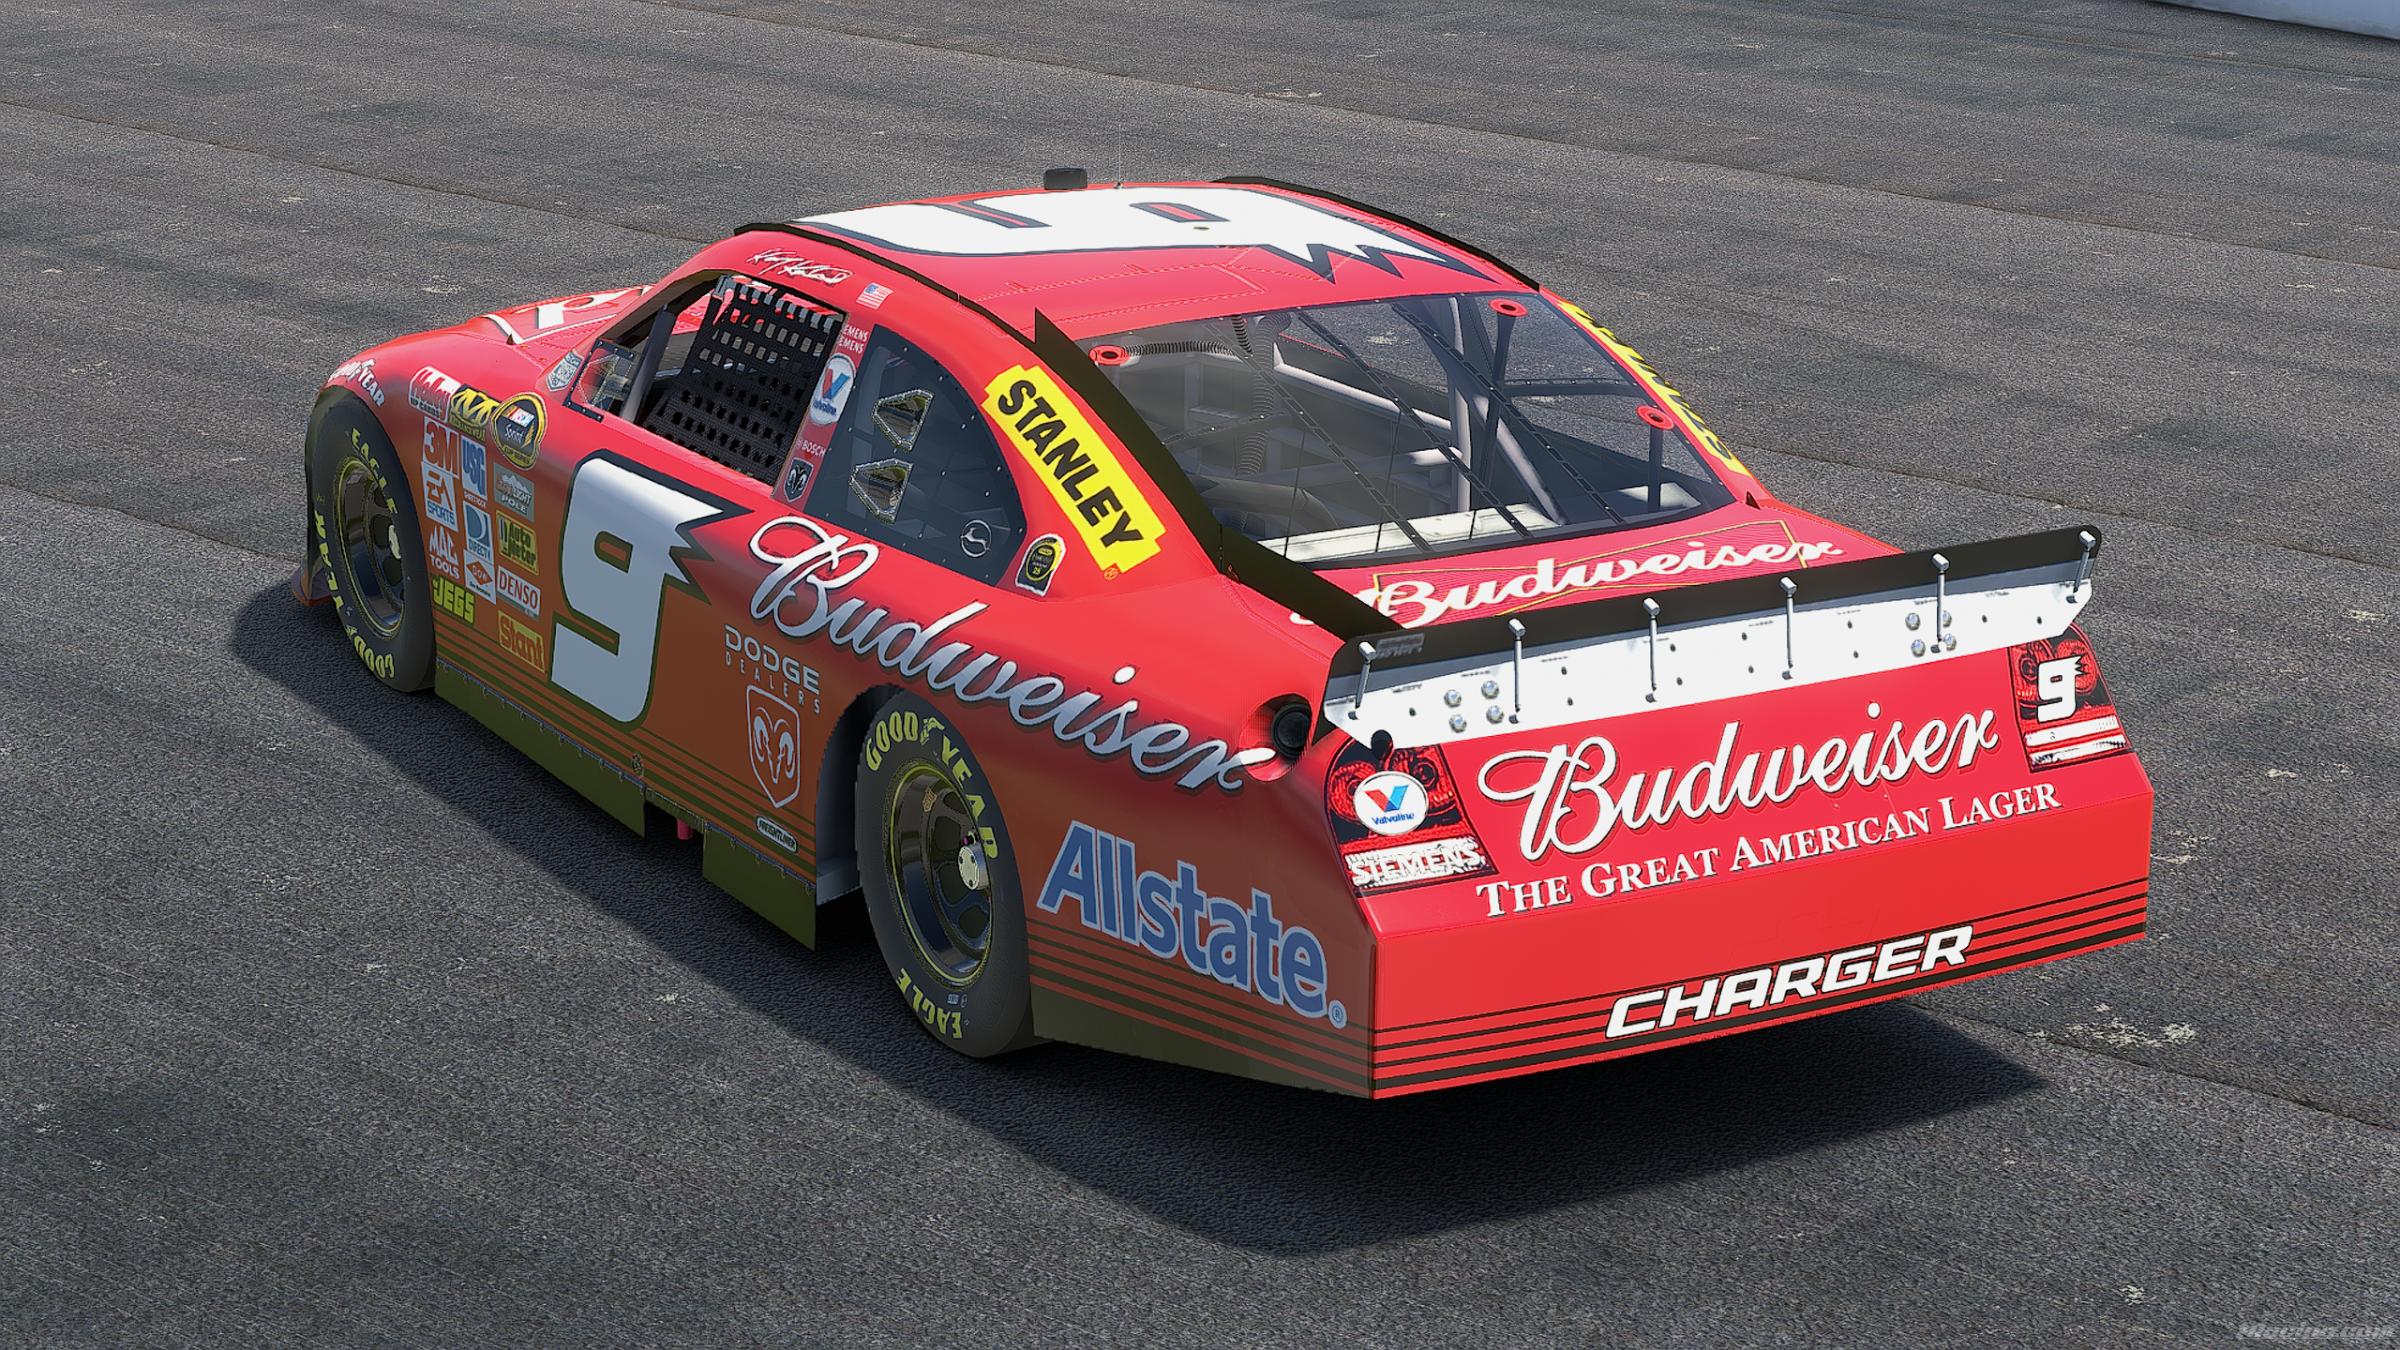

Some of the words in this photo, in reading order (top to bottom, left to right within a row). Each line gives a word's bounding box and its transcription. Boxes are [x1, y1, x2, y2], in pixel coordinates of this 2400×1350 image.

[424, 421, 458, 476] 3M
[462, 439, 487, 497] USG
[801, 439, 826, 457] BOSCH
[997, 379, 1142, 548] STANLEY
[427, 500, 455, 526] SPORTS
[502, 495, 528, 514] POLE
[429, 526, 459, 565] MAC
[430, 554, 460, 580] TOOLS
[432, 575, 475, 625] JEGS
[499, 570, 540, 610] DENSO
[551, 452, 735, 726] 9
[1289, 541, 1845, 629] Budweiser
[500, 618, 545, 670] Stant
[724, 623, 820, 695] DODGE
[748, 515, 1277, 790] Budweiser
[725, 651, 820, 715] DEALERS
[2037, 655, 2090, 724] 9
[1477, 701, 2000, 861] Budweiser
[1371, 811, 1415, 826] Valvoline
[1349, 843, 1483, 888] SIEMENS
[1475, 875, 1573, 919] THE
[1580, 853, 1720, 900] GREAT
[1730, 808, 1931, 874] AMERICAN
[1942, 782, 2063, 831] LAGER
[896, 967, 963, 1039] EAGLE
[1604, 924, 1977, 1041] CHARGER
